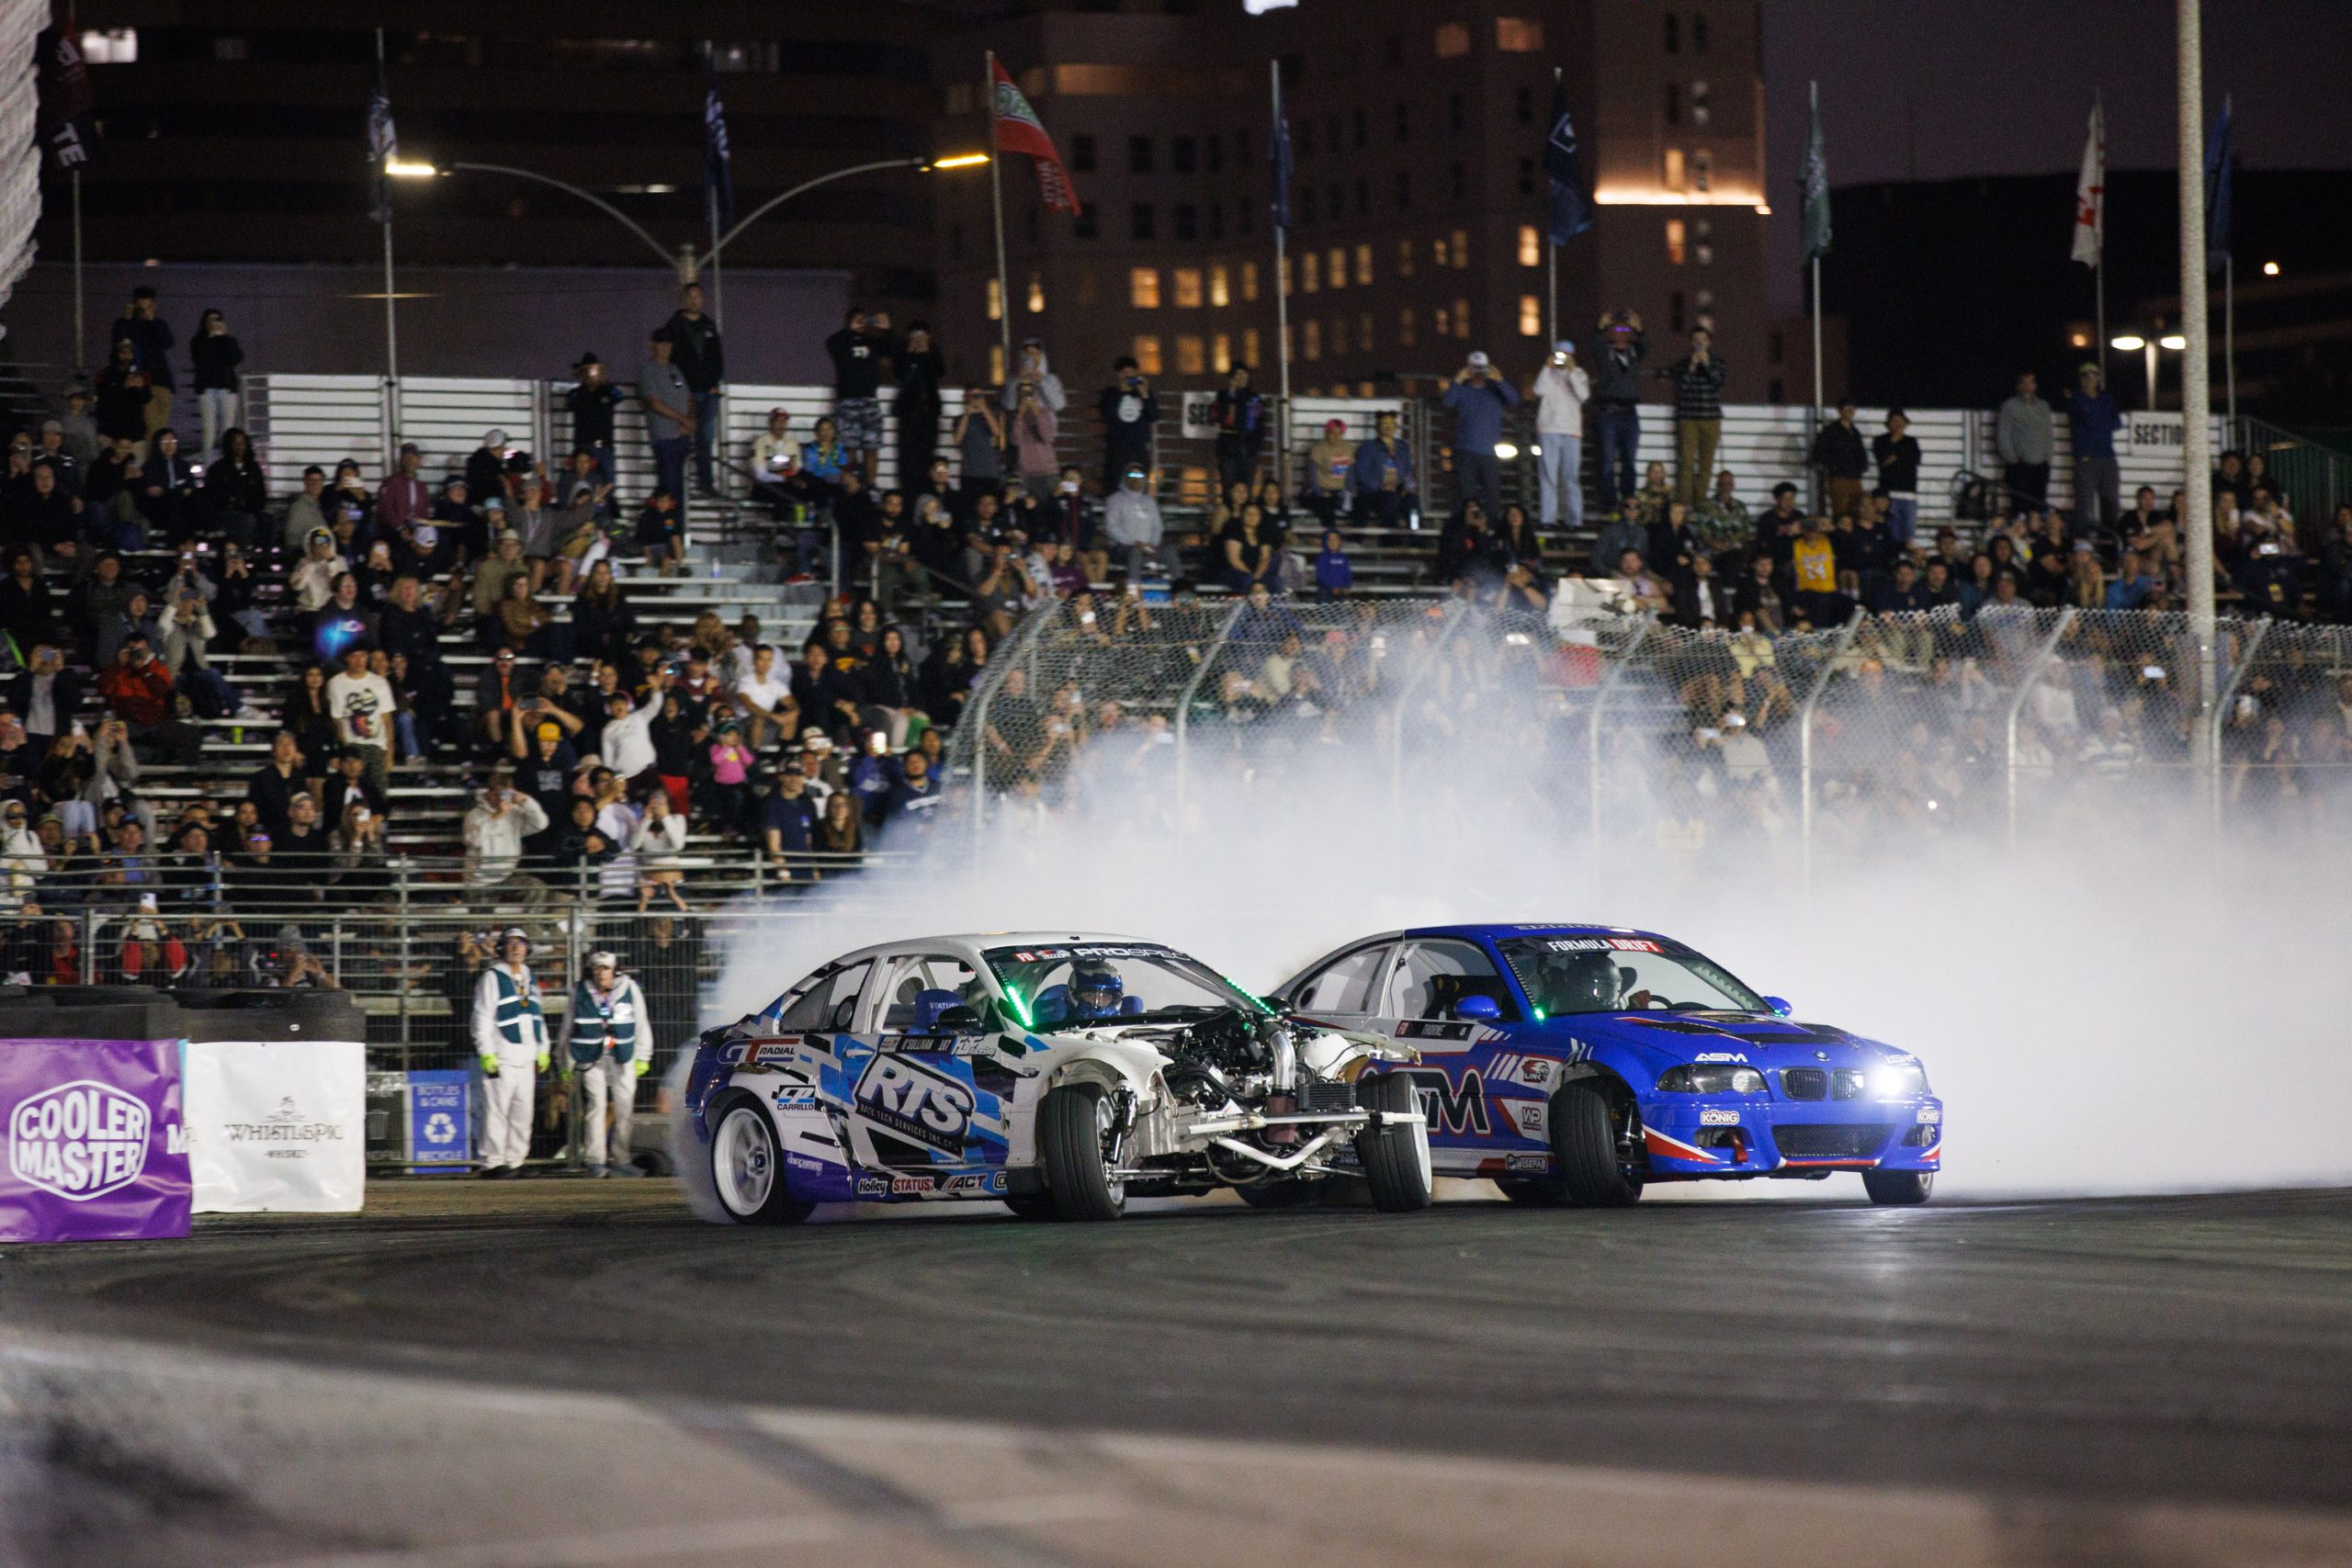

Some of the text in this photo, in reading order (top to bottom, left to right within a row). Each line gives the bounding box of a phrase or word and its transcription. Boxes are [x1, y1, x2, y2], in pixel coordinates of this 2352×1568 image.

[1547, 939, 1659, 952] FORMULA DRIFT
[1073, 948, 1192, 961] PROSPEC
[759, 1047, 796, 1055] RADIAL
[858, 1054, 972, 1133] RTS
[18, 1089, 144, 1140] COOLER
[893, 1117, 928, 1138] SERVICES
[18, 1141, 141, 1190] MASTER
[859, 1179, 887, 1196] Holley
[952, 1175, 986, 1190] ACT
